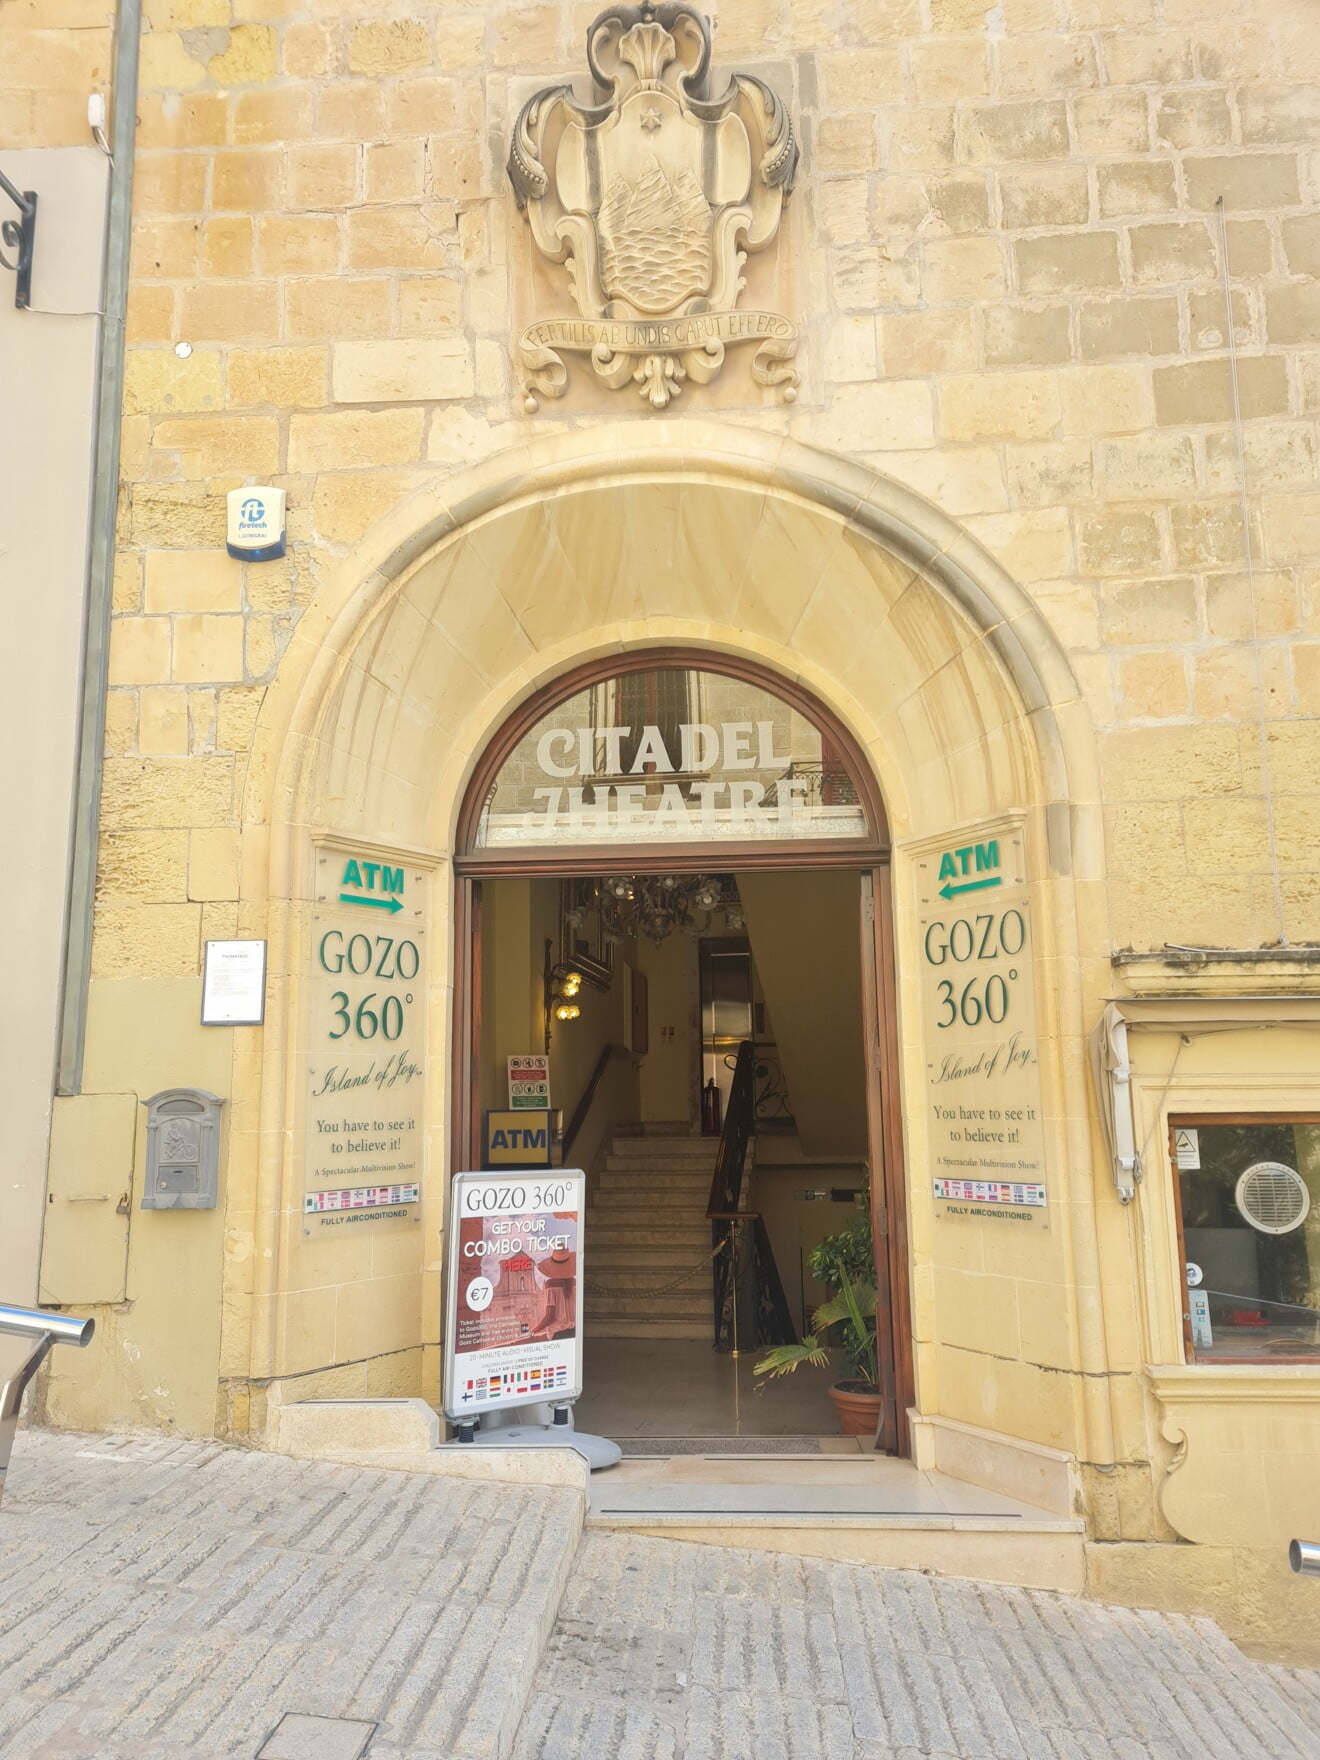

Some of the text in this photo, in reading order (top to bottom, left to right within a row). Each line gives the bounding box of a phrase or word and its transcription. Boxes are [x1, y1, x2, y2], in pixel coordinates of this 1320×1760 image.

[599, 325, 621, 344] AB
[625, 325, 671, 345] UNDIS
[674, 317, 722, 342] CAPUT
[729, 314, 790, 336] EFFERO
[536, 720, 792, 779] CITADEL
[522, 778, 812, 833] THEATRE
[938, 840, 1000, 881] ATM
[342, 859, 405, 894] ATM
[925, 909, 1025, 966] GOZO
[320, 930, 420, 980] GOZO
[937, 969, 1018, 1029] 360°
[329, 991, 413, 1041] 360°
[931, 1030, 1031, 1085] Island of Joy
[313, 1049, 417, 1096] Island of Joy
[933, 1105, 1036, 1120] You have to see it
[317, 1118, 415, 1133] You have to see it
[950, 1128, 1019, 1143] to believe it!
[332, 1138, 401, 1153] to believe it!
[491, 1130, 546, 1149] ATM
[314, 1168, 320, 1176] A
[322, 1166, 359, 1177] Spectacular
[360, 1164, 396, 1173] Multivision
[936, 1156, 942, 1164] A
[942, 1157, 978, 1168] Spectacular
[980, 1158, 1016, 1168] Multivision
[466, 1182, 572, 1211] GOZO 360°
[320, 1209, 408, 1226] FULLY AIRCONDITIONED
[947, 1206, 1032, 1220] FULLY AIRCONDITIONED
[492, 1220, 546, 1235] GET YOUR
[464, 1234, 570, 1258] COMBO TICKET
[502, 1258, 532, 1272] HERE
[471, 1288, 488, 1301] €7
